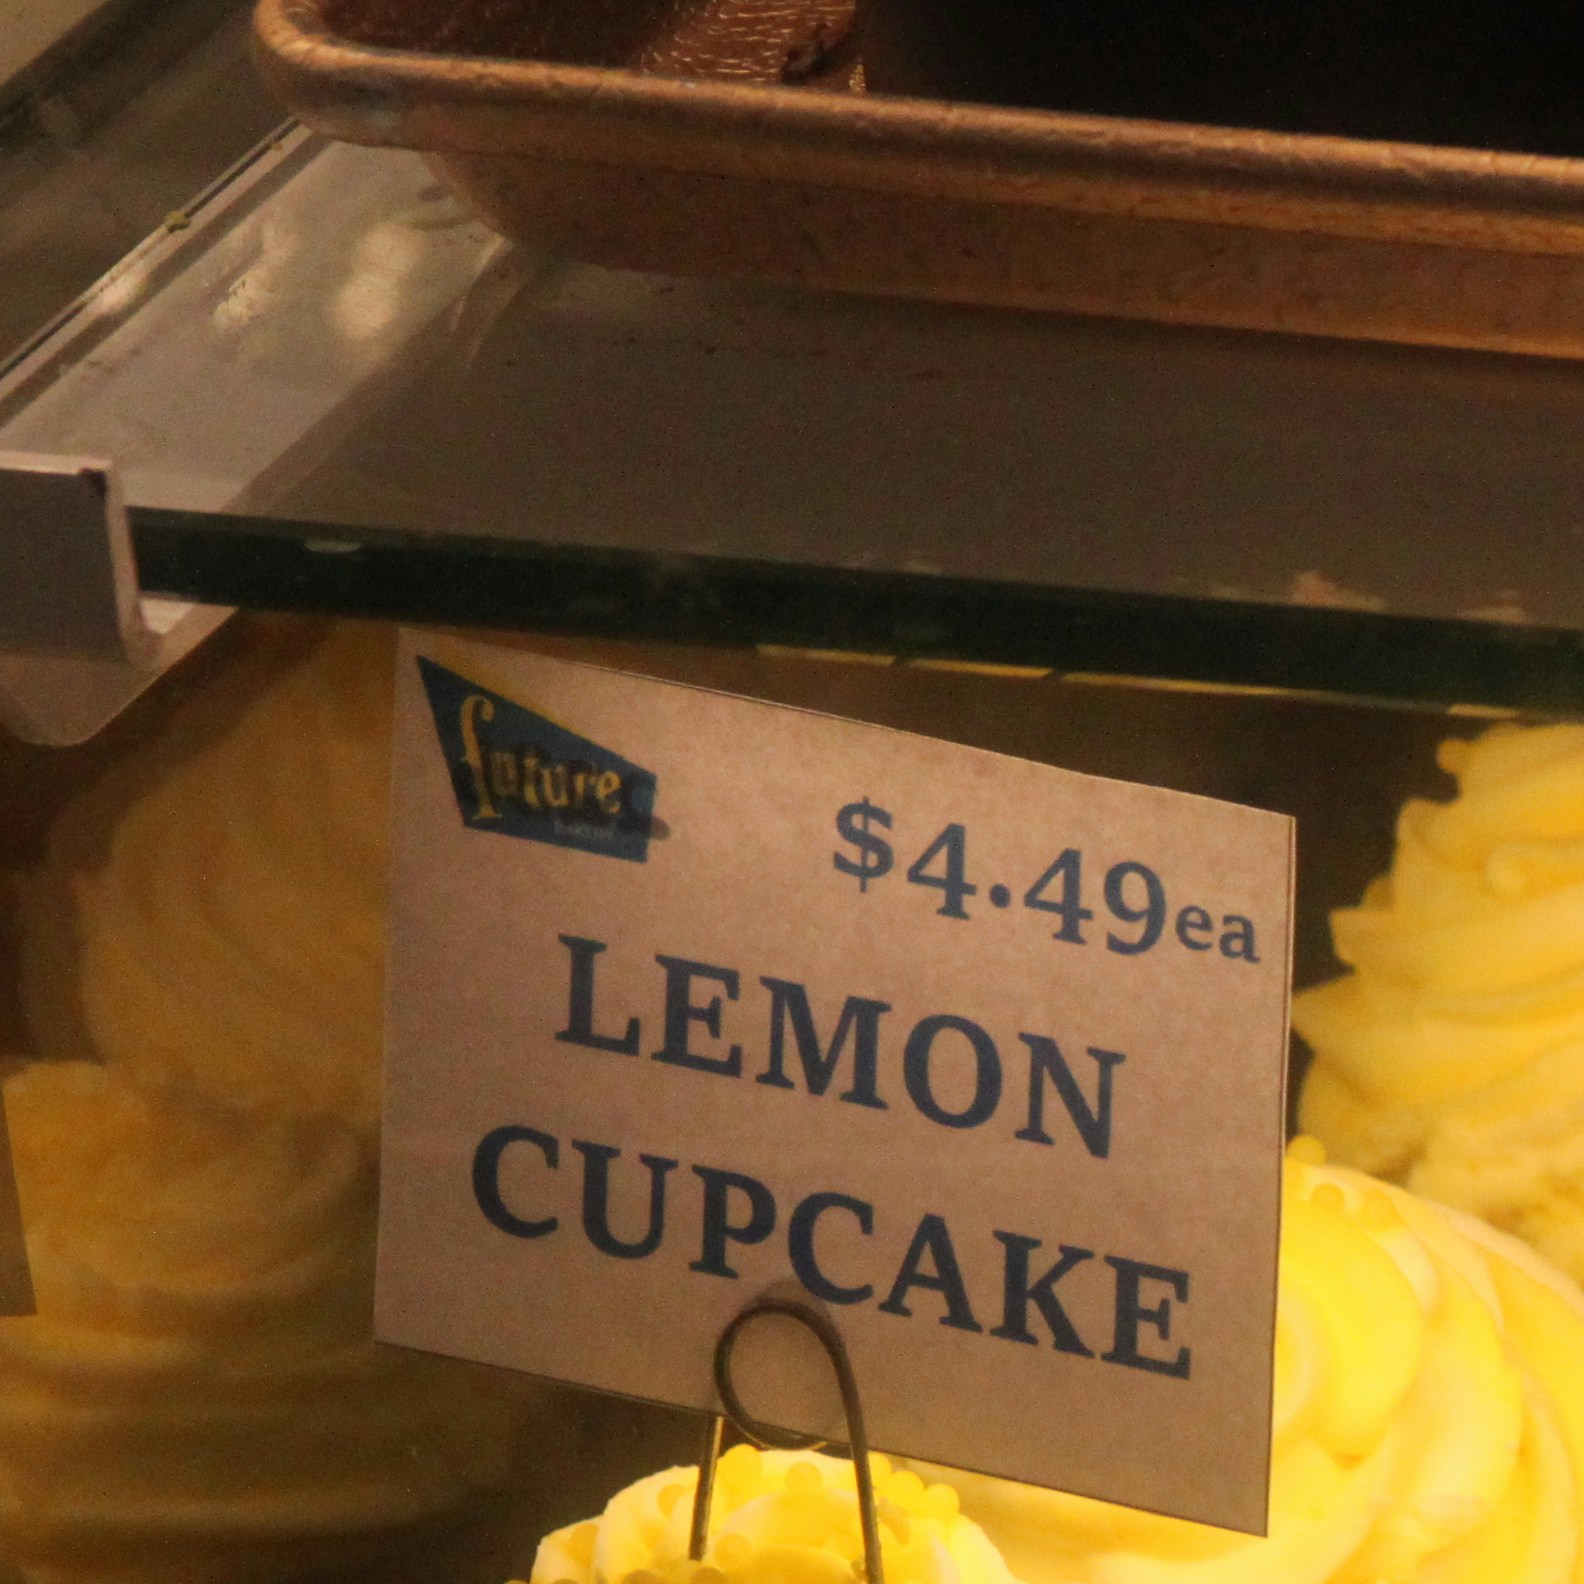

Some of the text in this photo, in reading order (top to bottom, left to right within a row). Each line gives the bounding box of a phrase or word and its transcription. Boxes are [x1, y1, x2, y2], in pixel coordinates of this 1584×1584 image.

[460, 694, 623, 821] future
[832, 797, 1261, 963] $4.49ea
[555, 934, 1126, 1159] LEMON
[471, 1124, 1192, 1380] CUPCAKE
